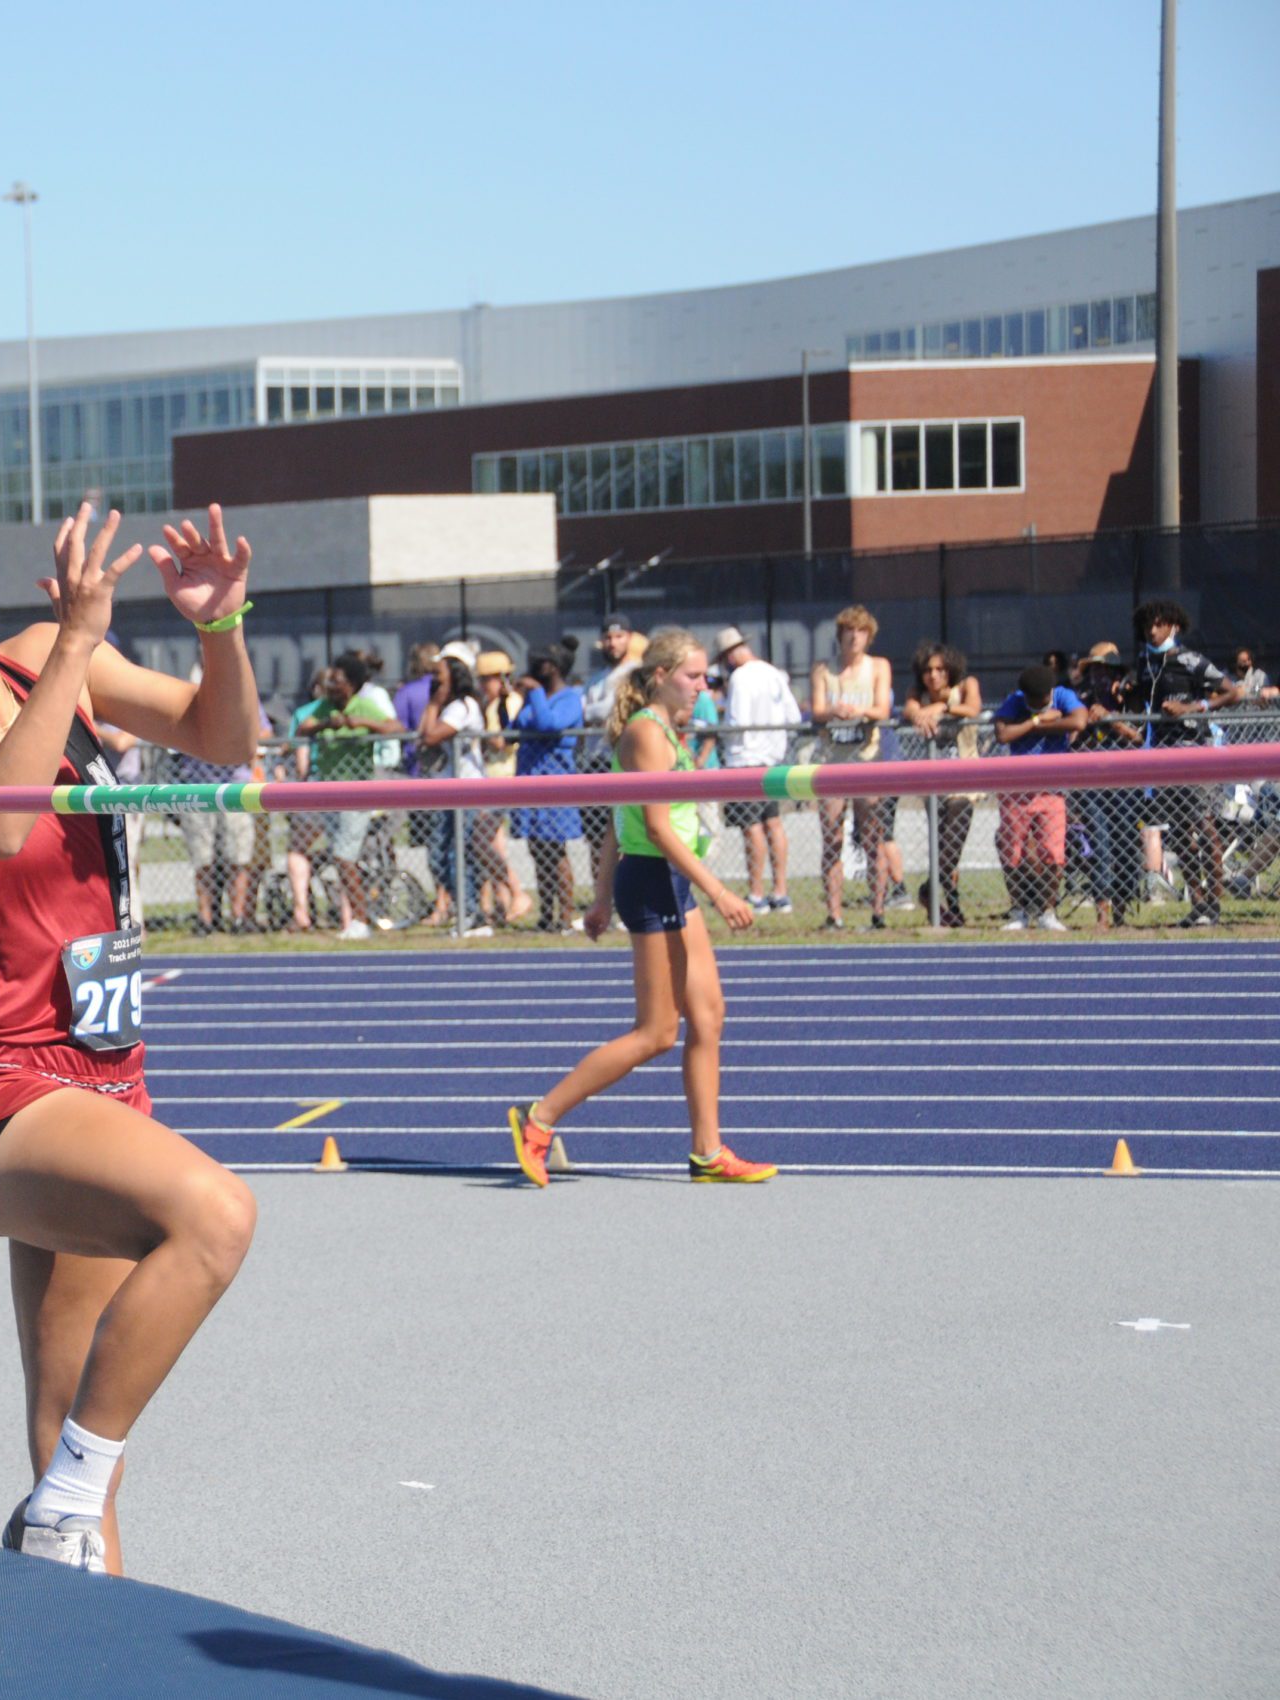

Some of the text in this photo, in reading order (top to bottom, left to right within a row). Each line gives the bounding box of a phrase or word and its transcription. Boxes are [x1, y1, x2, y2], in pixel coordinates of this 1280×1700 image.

[112, 938, 130, 950] 2021
[108, 951, 127, 963] Track
[74, 970, 142, 1036] 279
